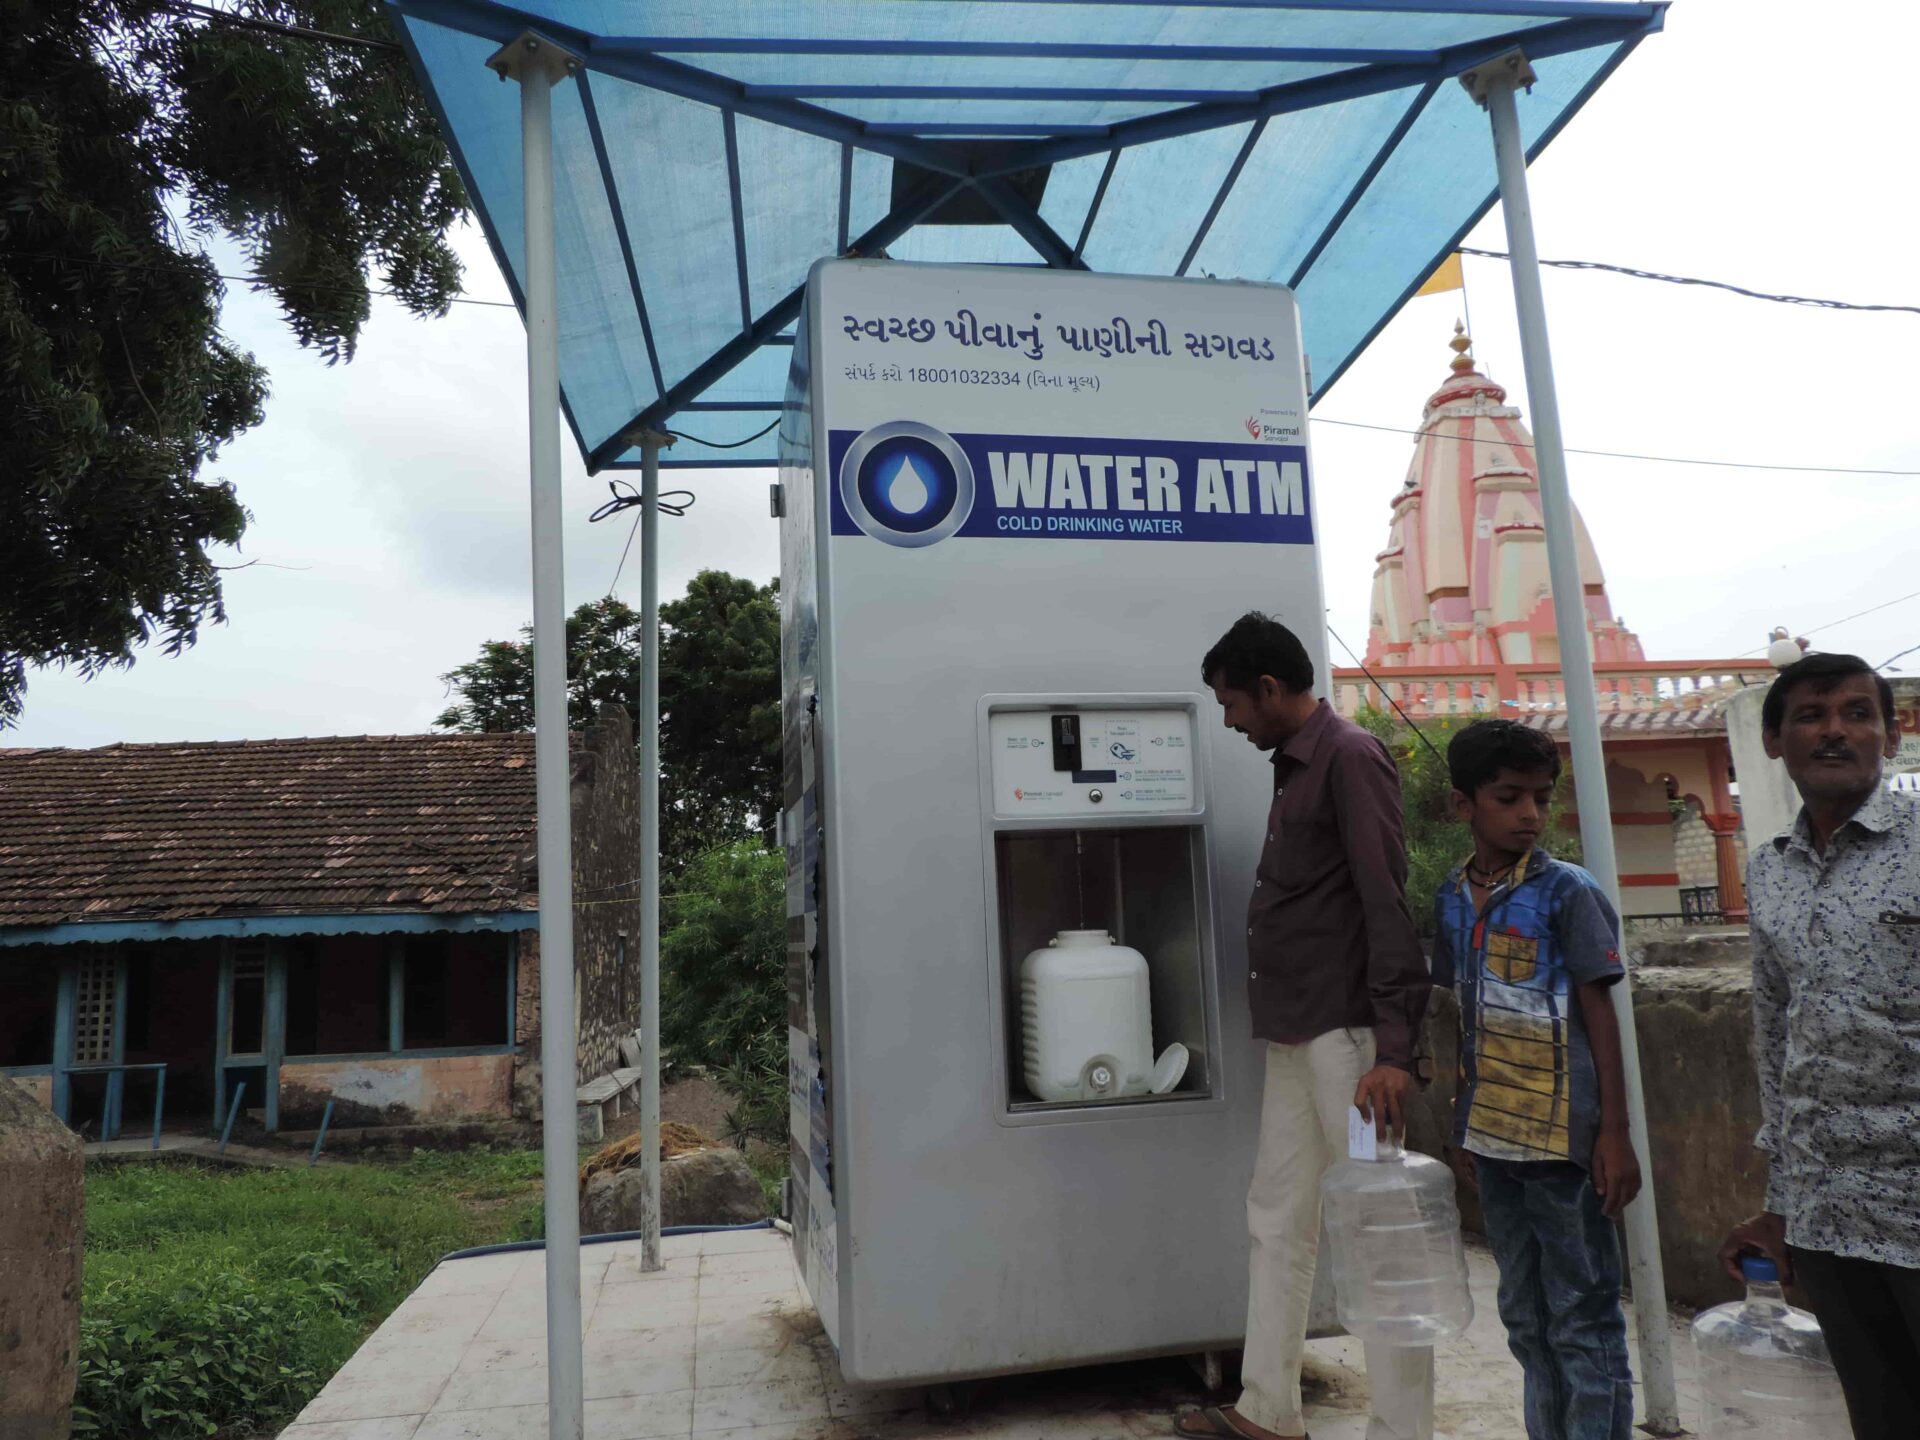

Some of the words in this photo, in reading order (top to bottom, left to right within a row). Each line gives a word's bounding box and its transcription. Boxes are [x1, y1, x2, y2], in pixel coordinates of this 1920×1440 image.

[944, 308, 1045, 361] પીવાનું
[1056, 316, 1173, 358] પાણીની
[1183, 332, 1275, 362] સગવડ
[881, 364, 903, 382] કરો
[908, 367, 1021, 386] 18001032334
[1263, 425, 1300, 436] Piramal
[987, 451, 1182, 512] WATER
[1194, 457, 1306, 516] ATM
[996, 515, 1043, 531] COLD
[1047, 516, 1125, 533] DRINKING
[1128, 518, 1183, 534] WATER
